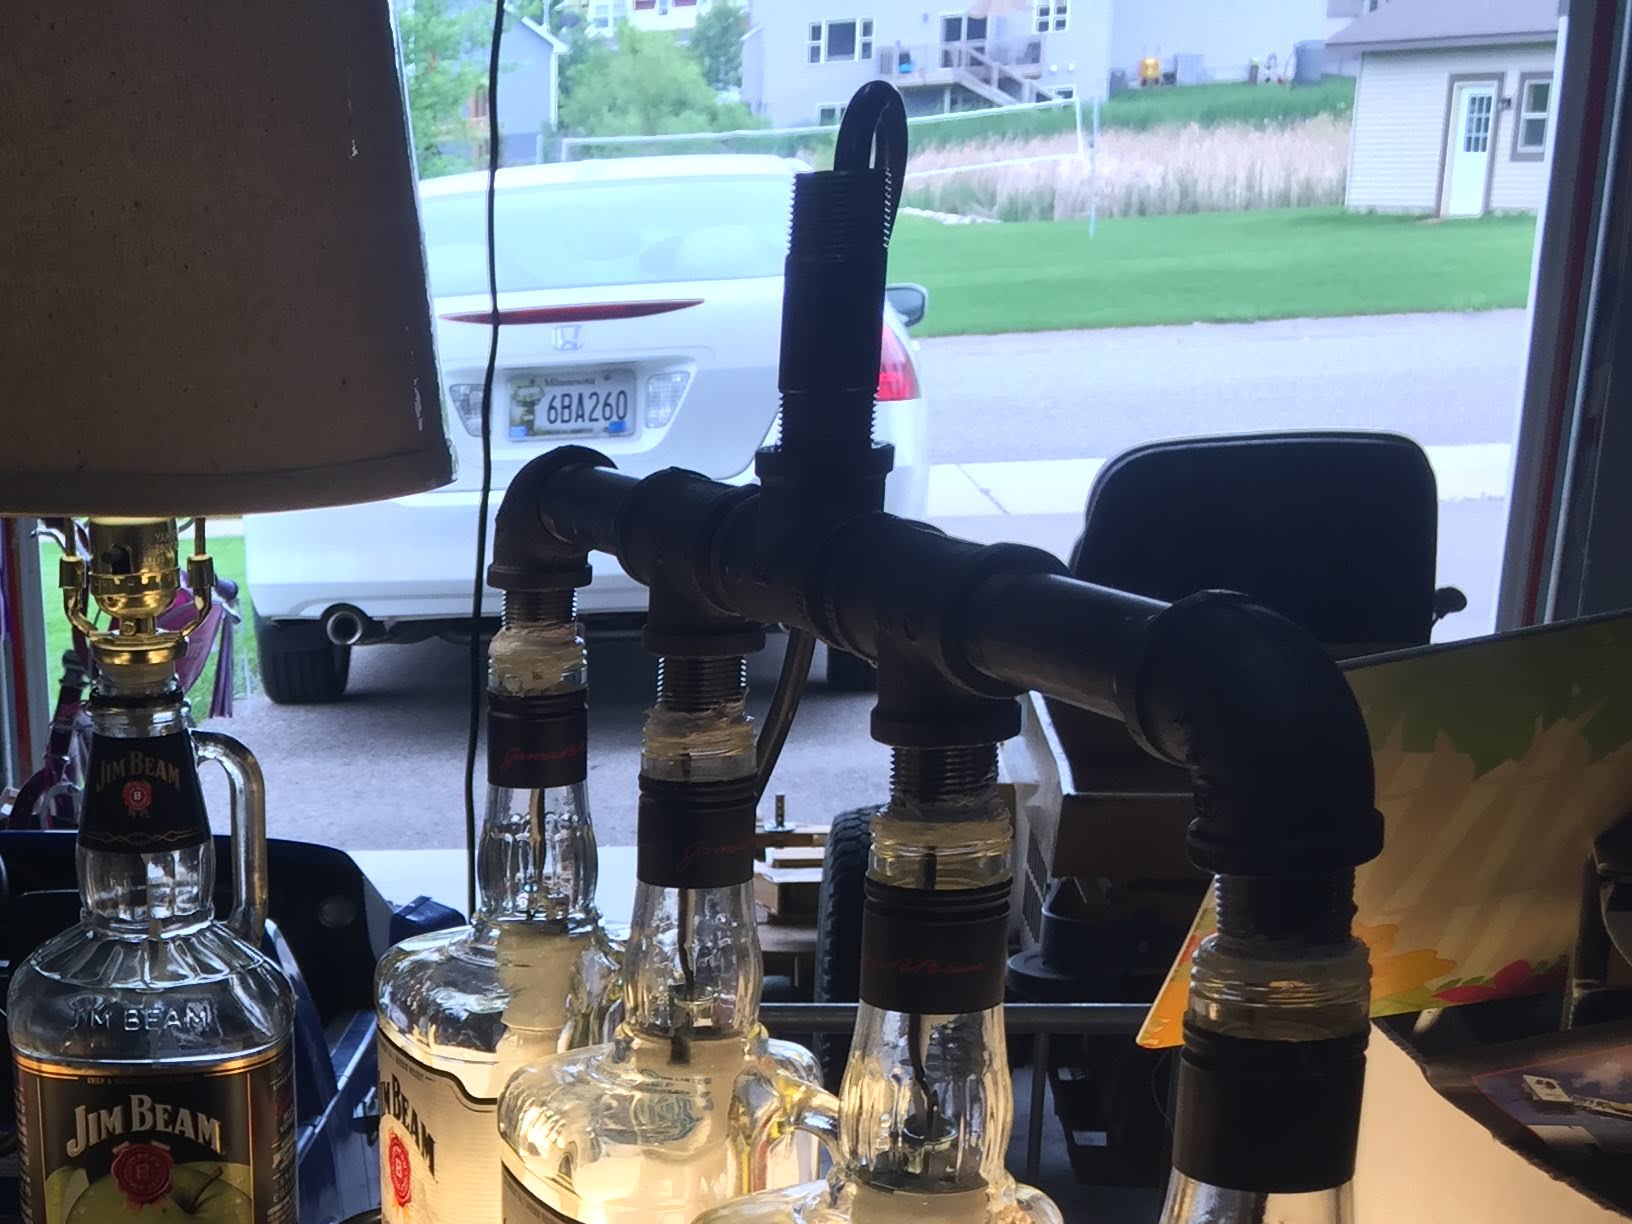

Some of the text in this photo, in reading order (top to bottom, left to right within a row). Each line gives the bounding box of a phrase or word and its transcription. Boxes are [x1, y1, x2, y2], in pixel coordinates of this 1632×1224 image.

[546, 389, 628, 424] 6BA260
[95, 750, 181, 793] JIM BEAM
[123, 1006, 212, 1033] BEAM
[66, 1104, 125, 1158] JIM
[128, 1093, 222, 1155] BEAM
[391, 1072, 436, 1181] BEAM
